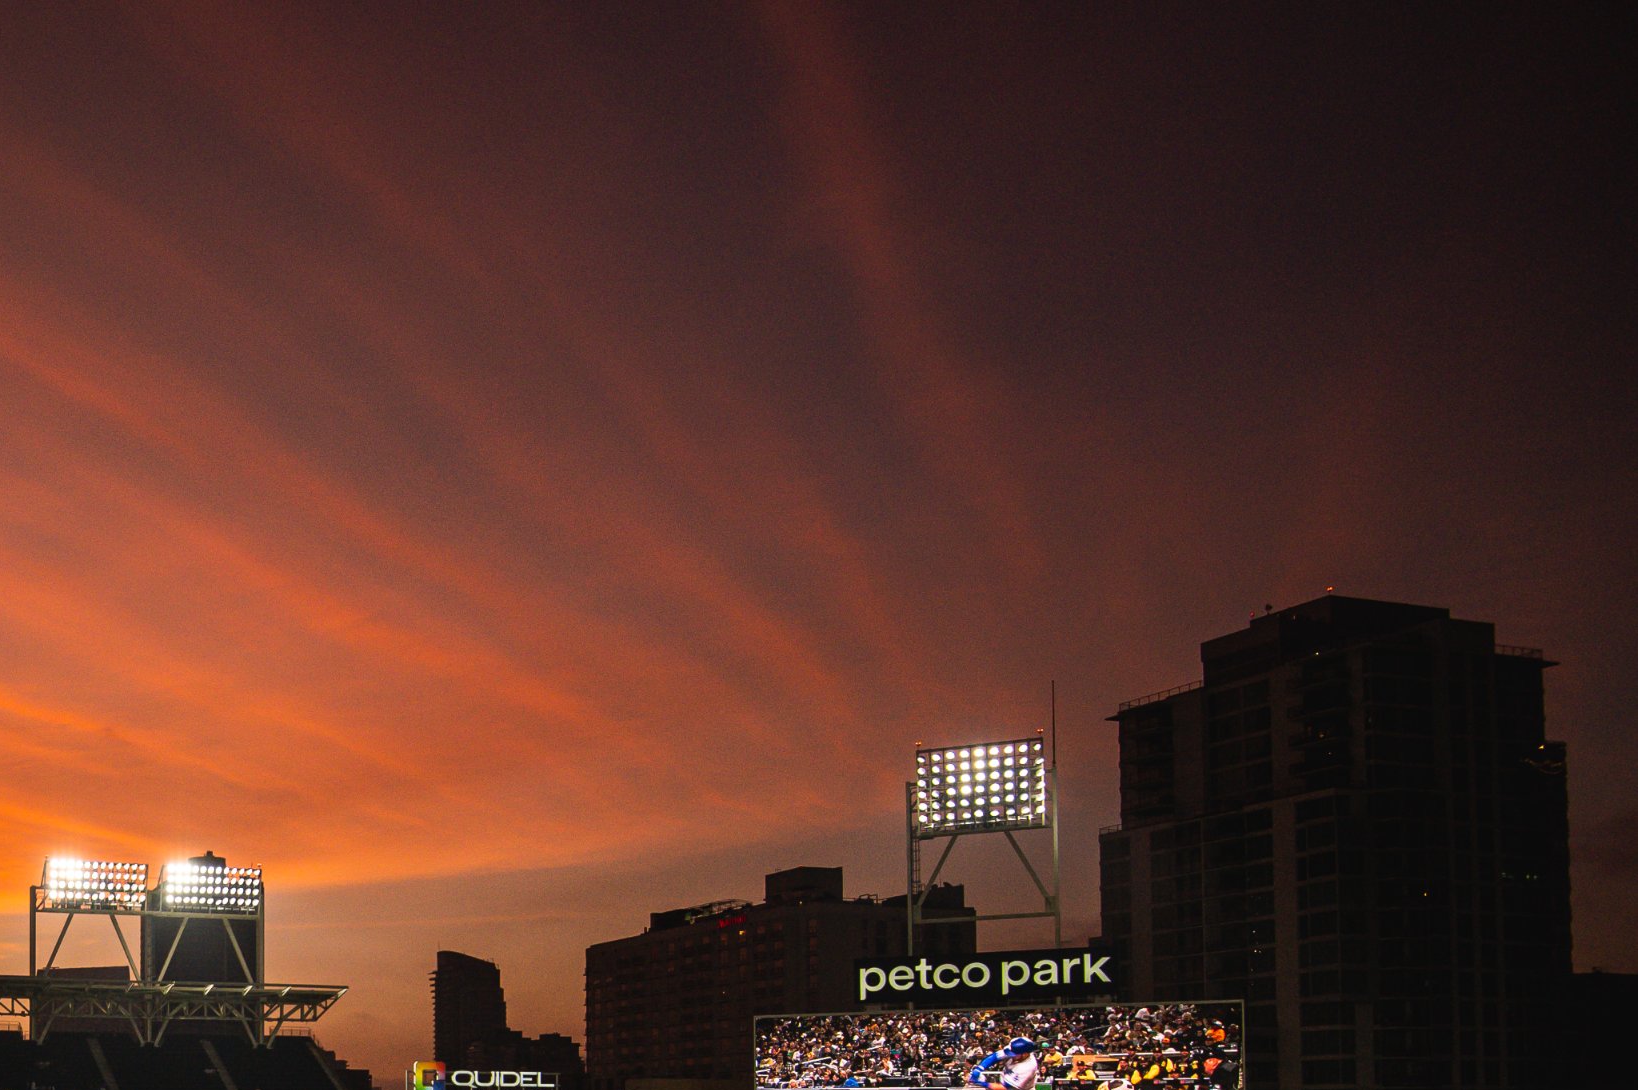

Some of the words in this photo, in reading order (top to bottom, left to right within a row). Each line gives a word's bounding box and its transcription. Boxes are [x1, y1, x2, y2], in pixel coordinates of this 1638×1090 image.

[859, 957, 992, 1001] petco
[1001, 953, 1113, 996] park
[451, 1070, 555, 1089] QUIDEL
